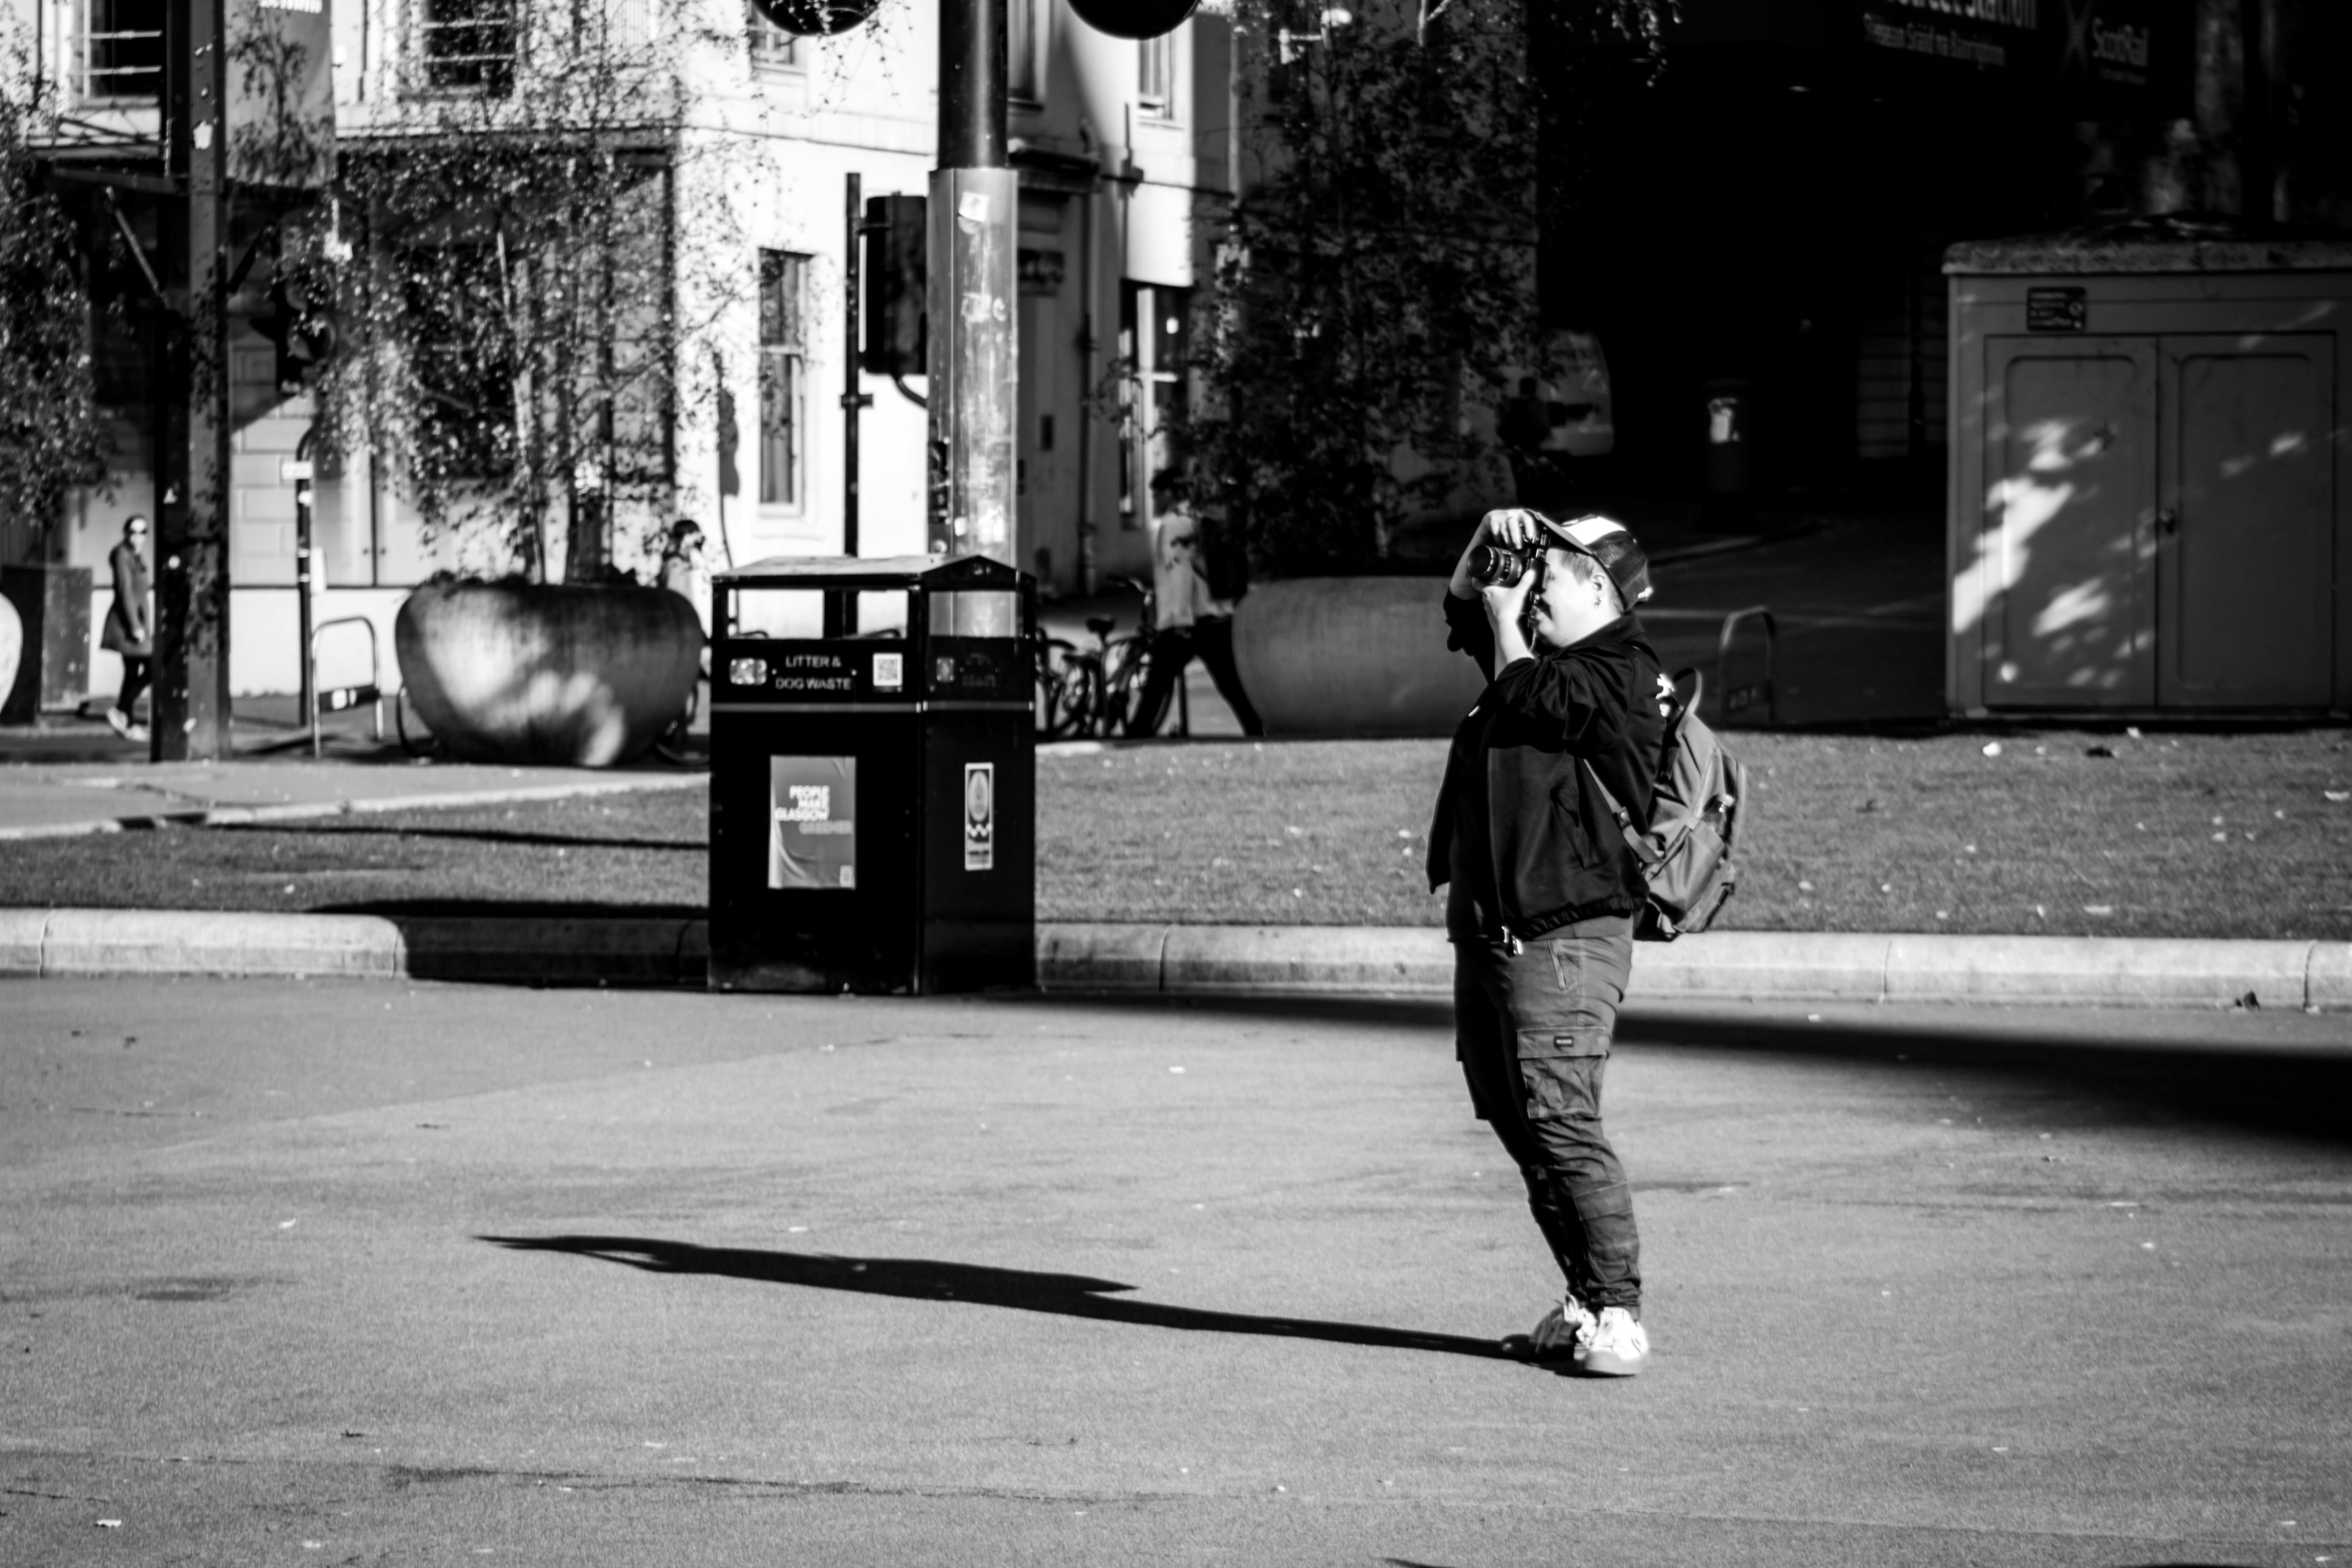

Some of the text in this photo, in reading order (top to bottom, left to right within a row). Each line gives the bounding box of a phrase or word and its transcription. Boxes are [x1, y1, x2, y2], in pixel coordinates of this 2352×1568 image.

[2091, 16, 2149, 68] ScotRail
[785, 653, 842, 668] LITTER &
[775, 676, 852, 691] DOG WASTE
[790, 785, 830, 799] PEOPLE
[798, 797, 830, 810] MAKE
[774, 807, 830, 821] GLASGOW
[799, 820, 852, 834] GREENER
